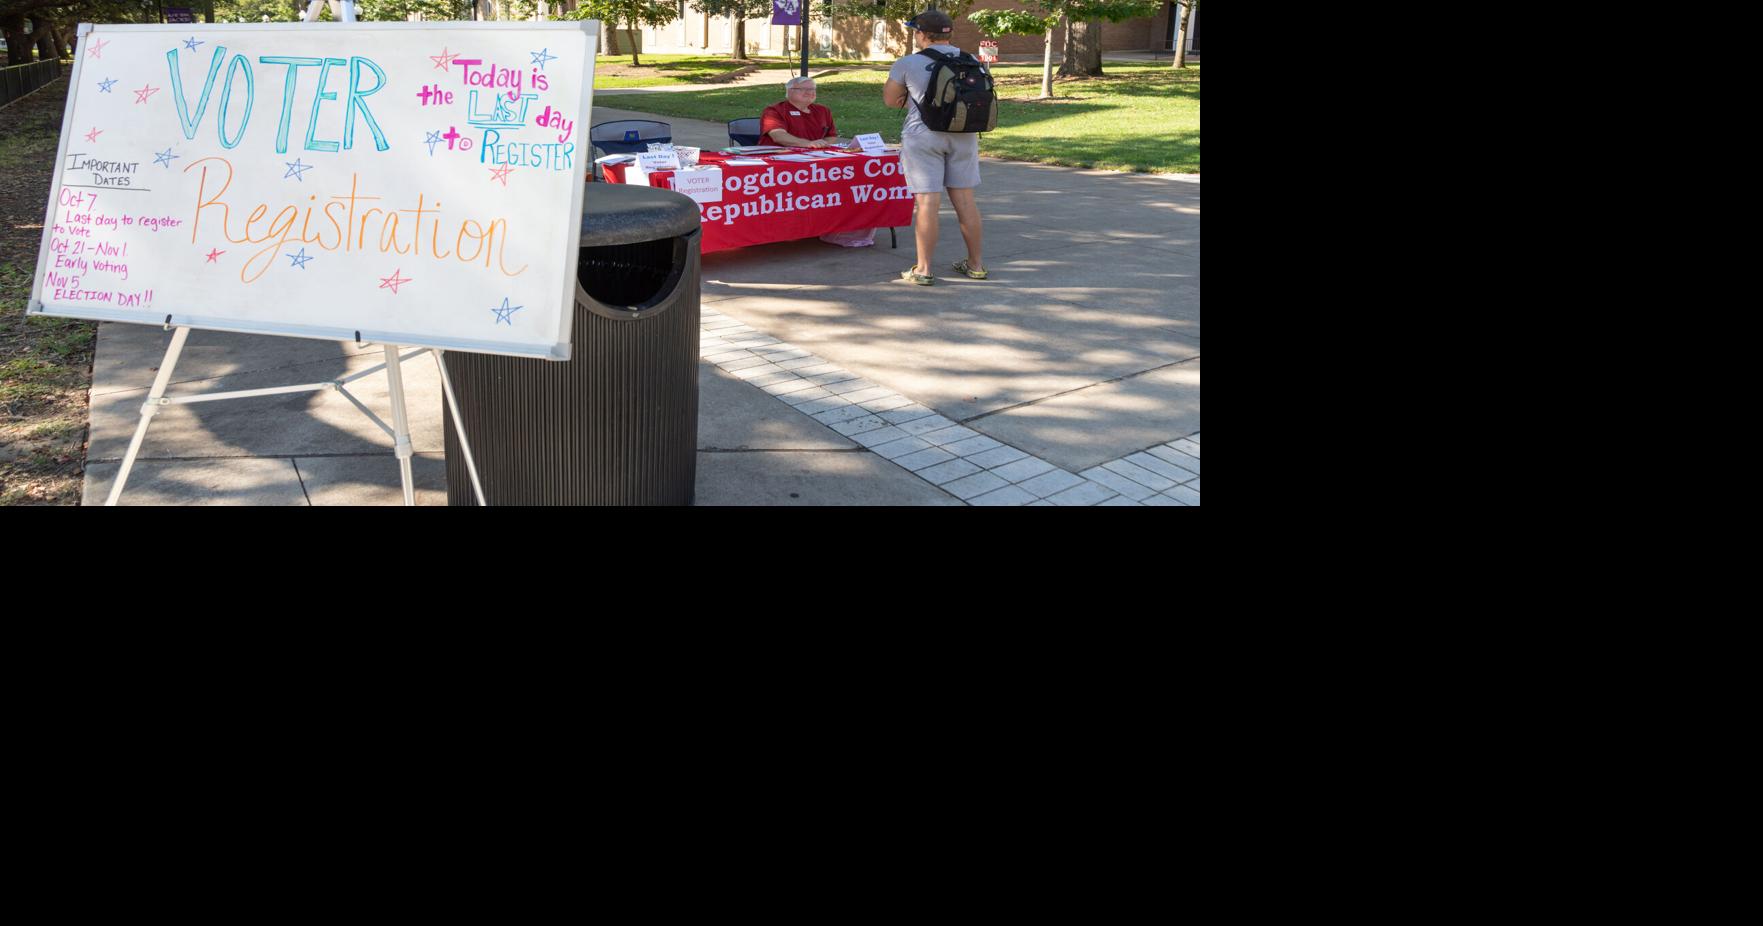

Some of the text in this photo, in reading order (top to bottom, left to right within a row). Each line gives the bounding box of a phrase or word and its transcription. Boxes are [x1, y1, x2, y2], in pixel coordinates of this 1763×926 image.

[452, 59, 549, 101] Today is
[167, 46, 390, 153] VOTER
[416, 84, 573, 143] the LAST day
[443, 126, 575, 171] to REGISTER
[67, 153, 139, 173] IMPORTANT
[93, 173, 130, 186] DATES
[687, 177, 710, 185] VOTER
[59, 187, 97, 212] Oct 7
[51, 224, 65, 235] to
[65, 210, 182, 232] Last day to register
[184, 157, 528, 283] Registration
[50, 237, 68, 253] Oct
[55, 255, 88, 276] Early
[45, 272, 80, 288] Nov 5
[54, 289, 112, 302] ELECTION
